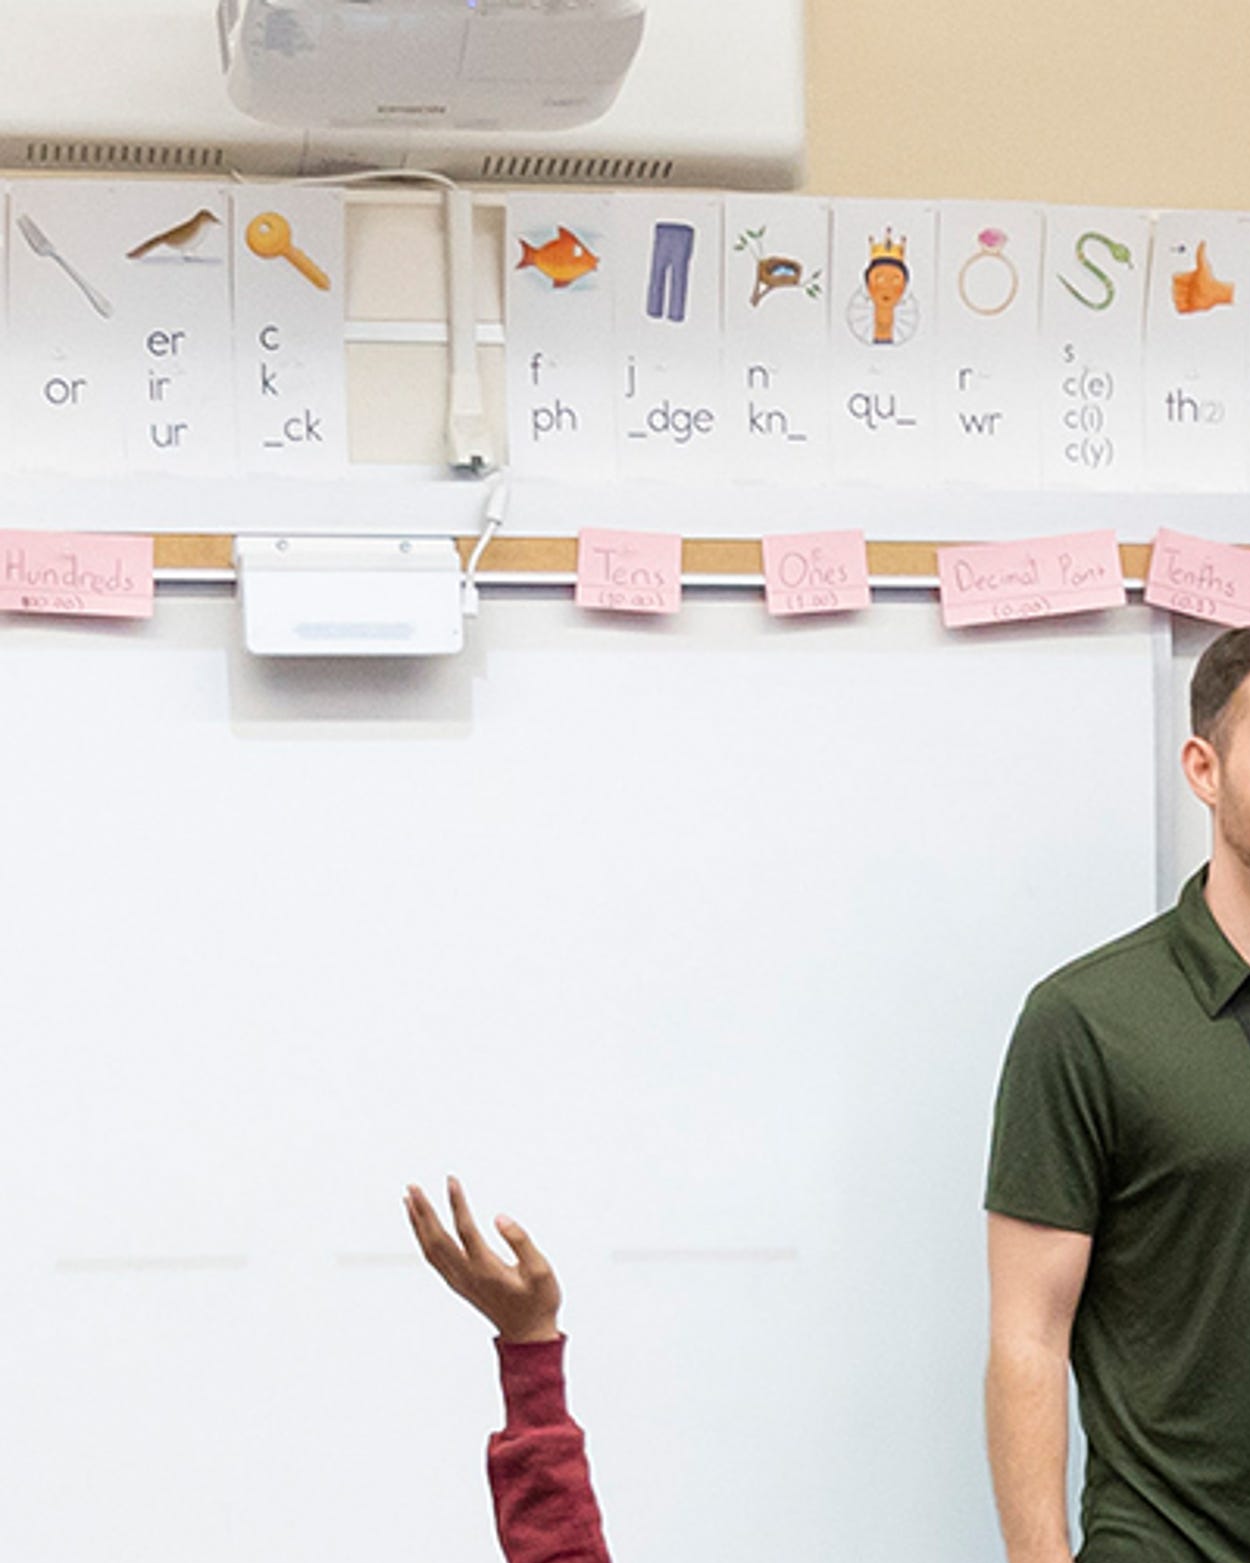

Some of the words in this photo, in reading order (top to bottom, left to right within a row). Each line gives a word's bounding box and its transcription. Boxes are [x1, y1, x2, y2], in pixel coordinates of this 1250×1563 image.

[146, 328, 185, 356] er
[259, 324, 280, 350] c
[1063, 344, 1076, 363] s
[261, 364, 278, 396] k
[530, 352, 543, 386] f
[625, 356, 636, 398] j
[747, 364, 769, 389] n
[958, 367, 973, 391] r
[44, 376, 87, 405] or
[149, 371, 171, 400] ir
[1062, 370, 1114, 400] c(e)
[151, 421, 188, 448] ur
[531, 400, 577, 441] ph
[958, 411, 1002, 436] wr
[5, 548, 134, 595] Hundreds
[592, 546, 666, 587] Tens
[778, 551, 849, 589] Ones
[1162, 546, 1237, 598] Tenths
